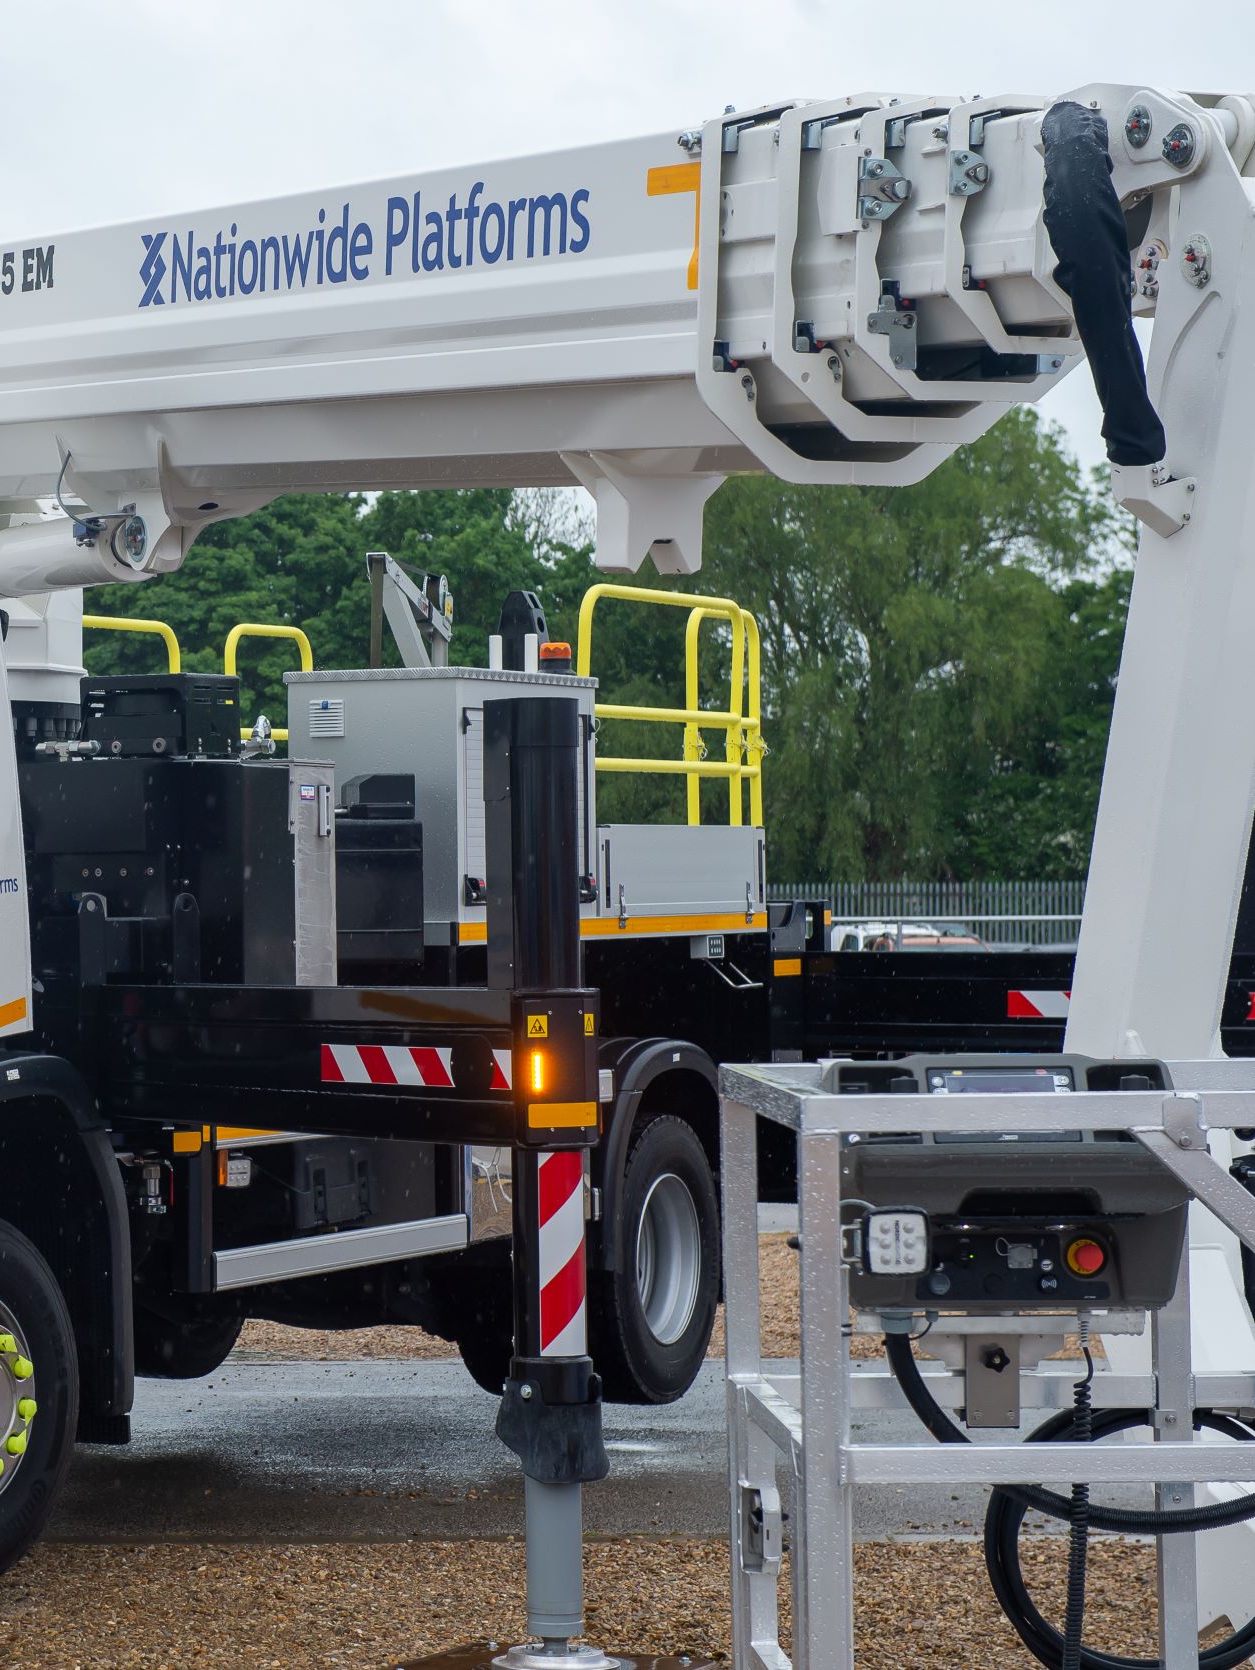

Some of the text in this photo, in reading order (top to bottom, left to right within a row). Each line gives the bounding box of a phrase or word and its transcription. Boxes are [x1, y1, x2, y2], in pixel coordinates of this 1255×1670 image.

[21, 244, 55, 293] EM
[171, 181, 591, 304] Nationwide Platforms
